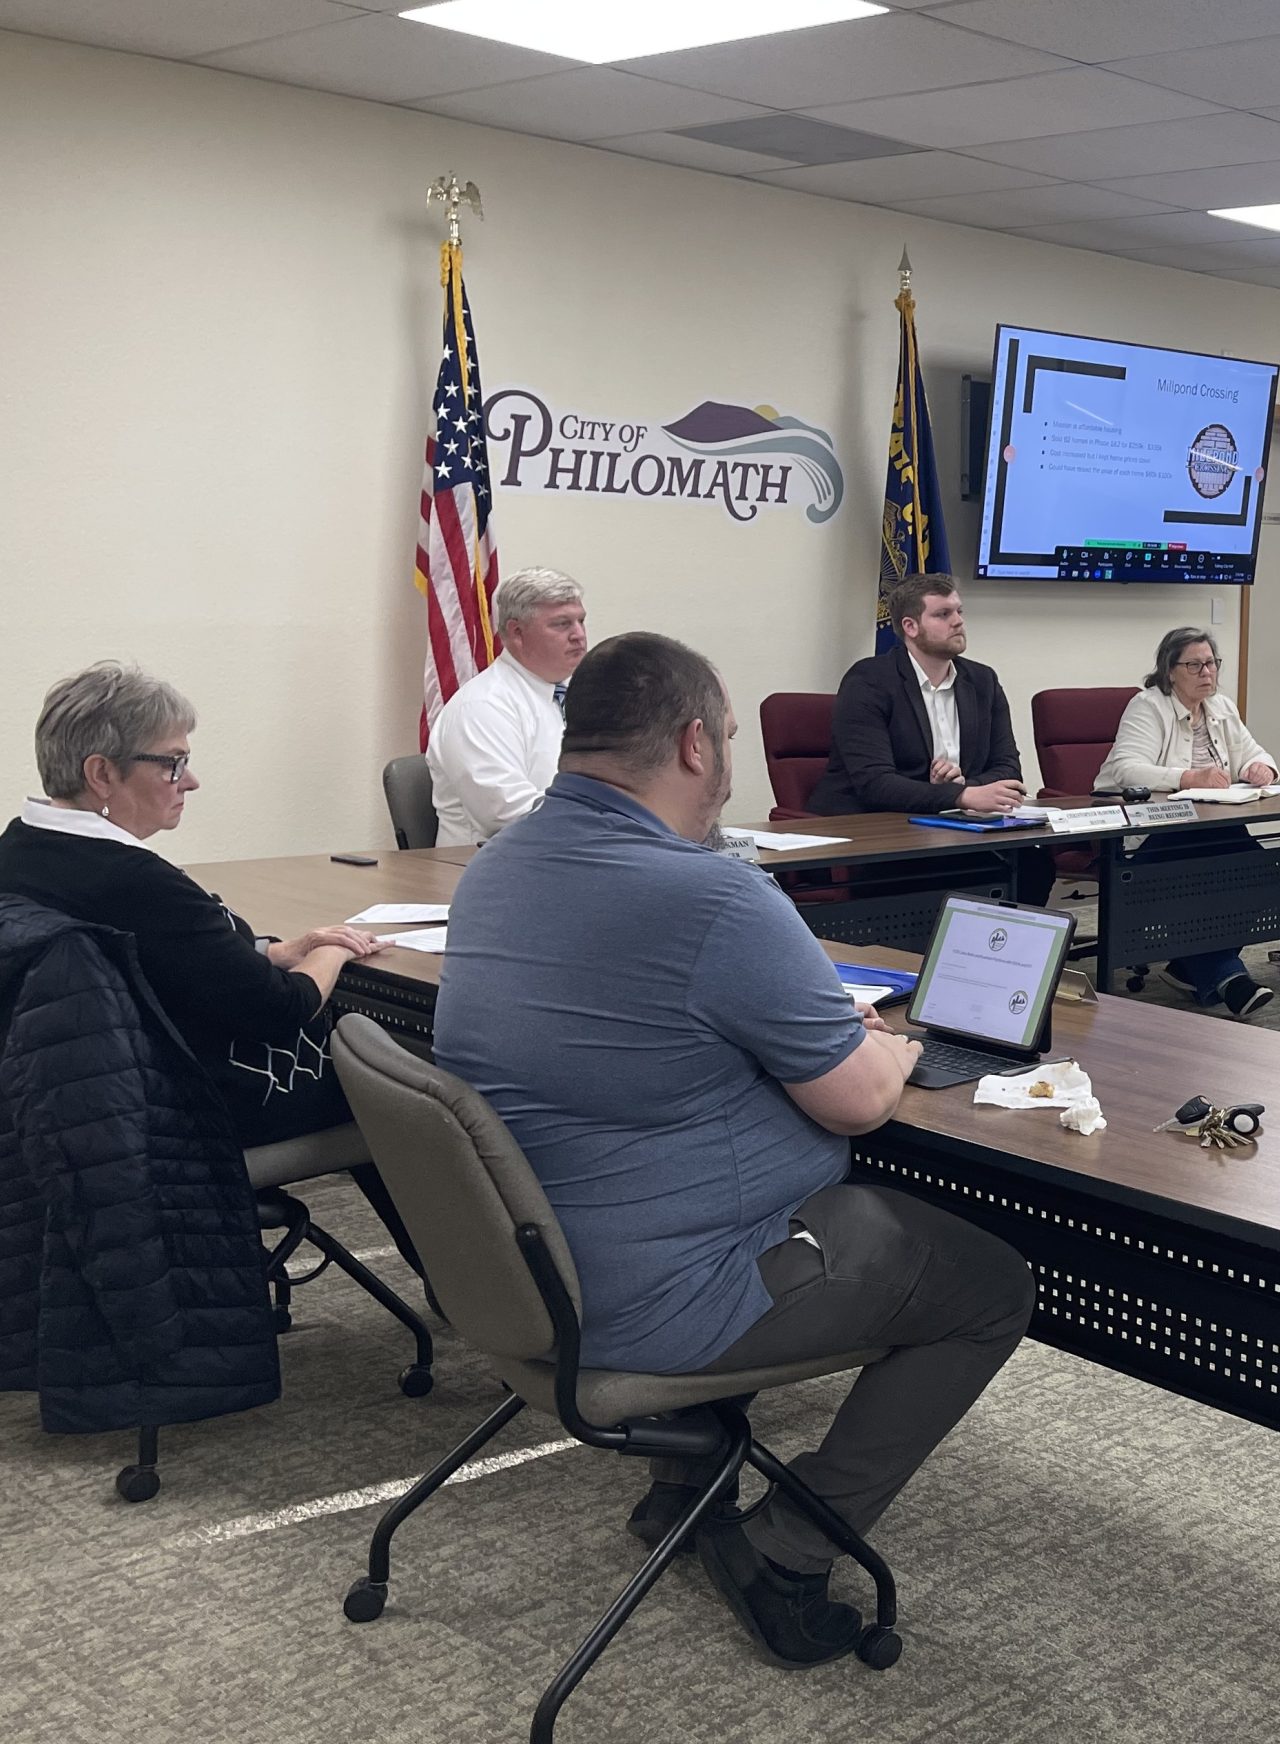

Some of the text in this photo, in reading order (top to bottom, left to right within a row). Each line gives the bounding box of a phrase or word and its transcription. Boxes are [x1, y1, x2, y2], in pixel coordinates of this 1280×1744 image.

[1157, 378, 1240, 404] Millpond Crossing
[559, 414, 648, 453] CITY OF
[482, 389, 792, 522] PHILOMATH
[1160, 804, 1184, 812] MEETING
[1165, 811, 1194, 819] RECORDED
